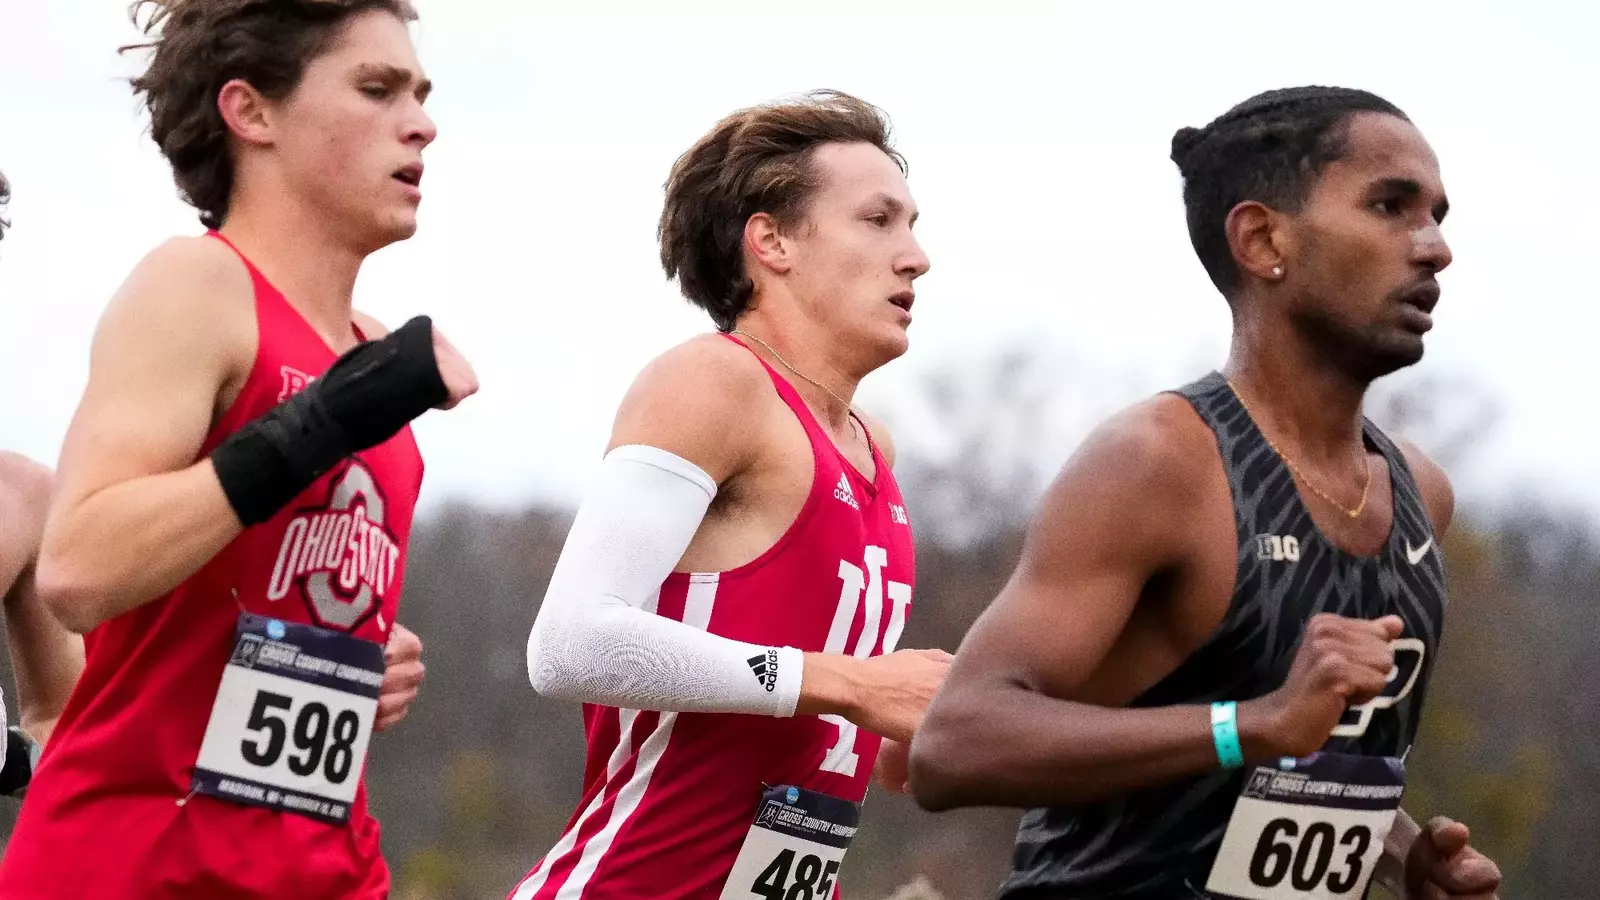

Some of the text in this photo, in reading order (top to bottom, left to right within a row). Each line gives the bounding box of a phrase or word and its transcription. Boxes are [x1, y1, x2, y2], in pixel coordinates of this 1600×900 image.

[267, 515, 350, 601] OHIO
[765, 649, 778, 692] adidas
[240, 689, 360, 784] 598
[777, 809, 804, 825] CROSS
[801, 816, 832, 833] COUNTRY
[1249, 817, 1371, 894] 603
